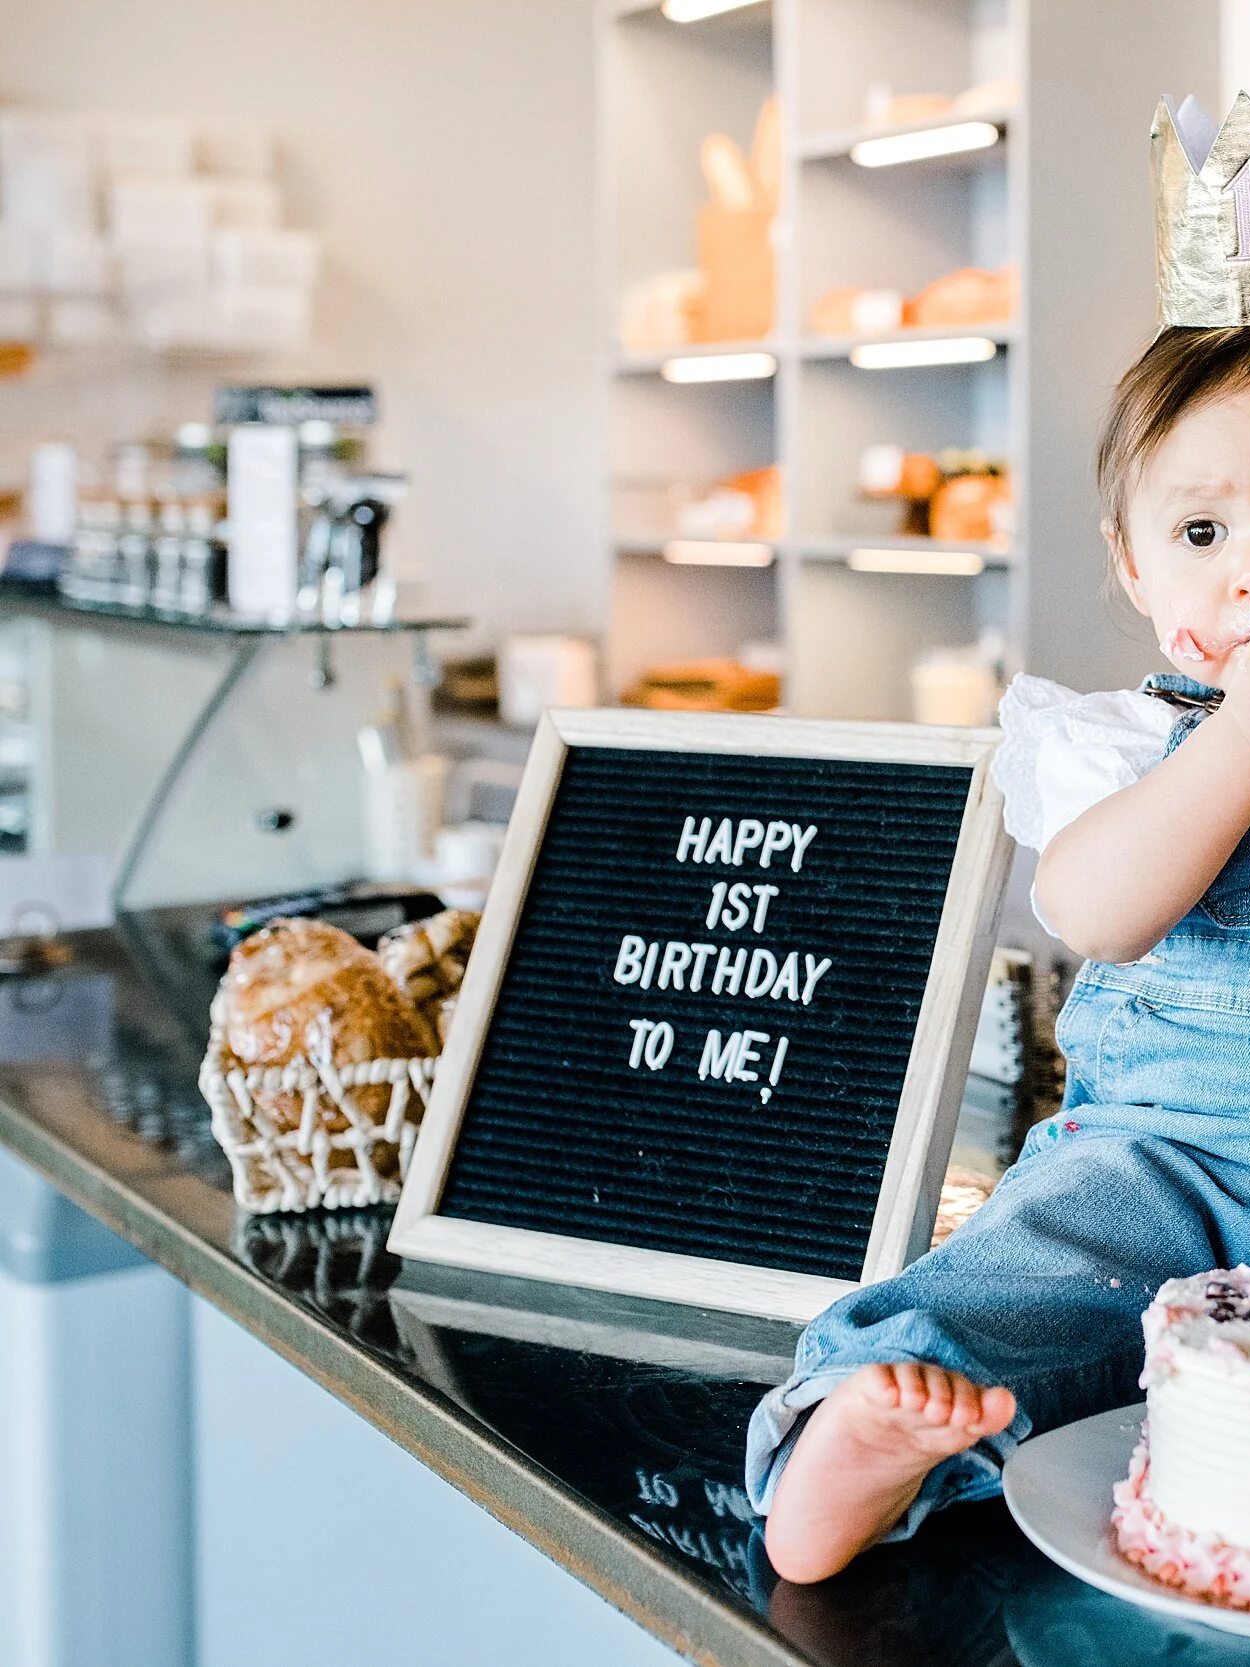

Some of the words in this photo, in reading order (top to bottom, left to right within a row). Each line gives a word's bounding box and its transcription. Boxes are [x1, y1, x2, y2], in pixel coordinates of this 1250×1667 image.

[675, 815, 818, 873] HAPPY
[705, 881, 780, 934] 1ST
[613, 934, 833, 1006] BIRTHDAY
[629, 1018, 674, 1071] TO
[698, 1028, 790, 1105] ME!
